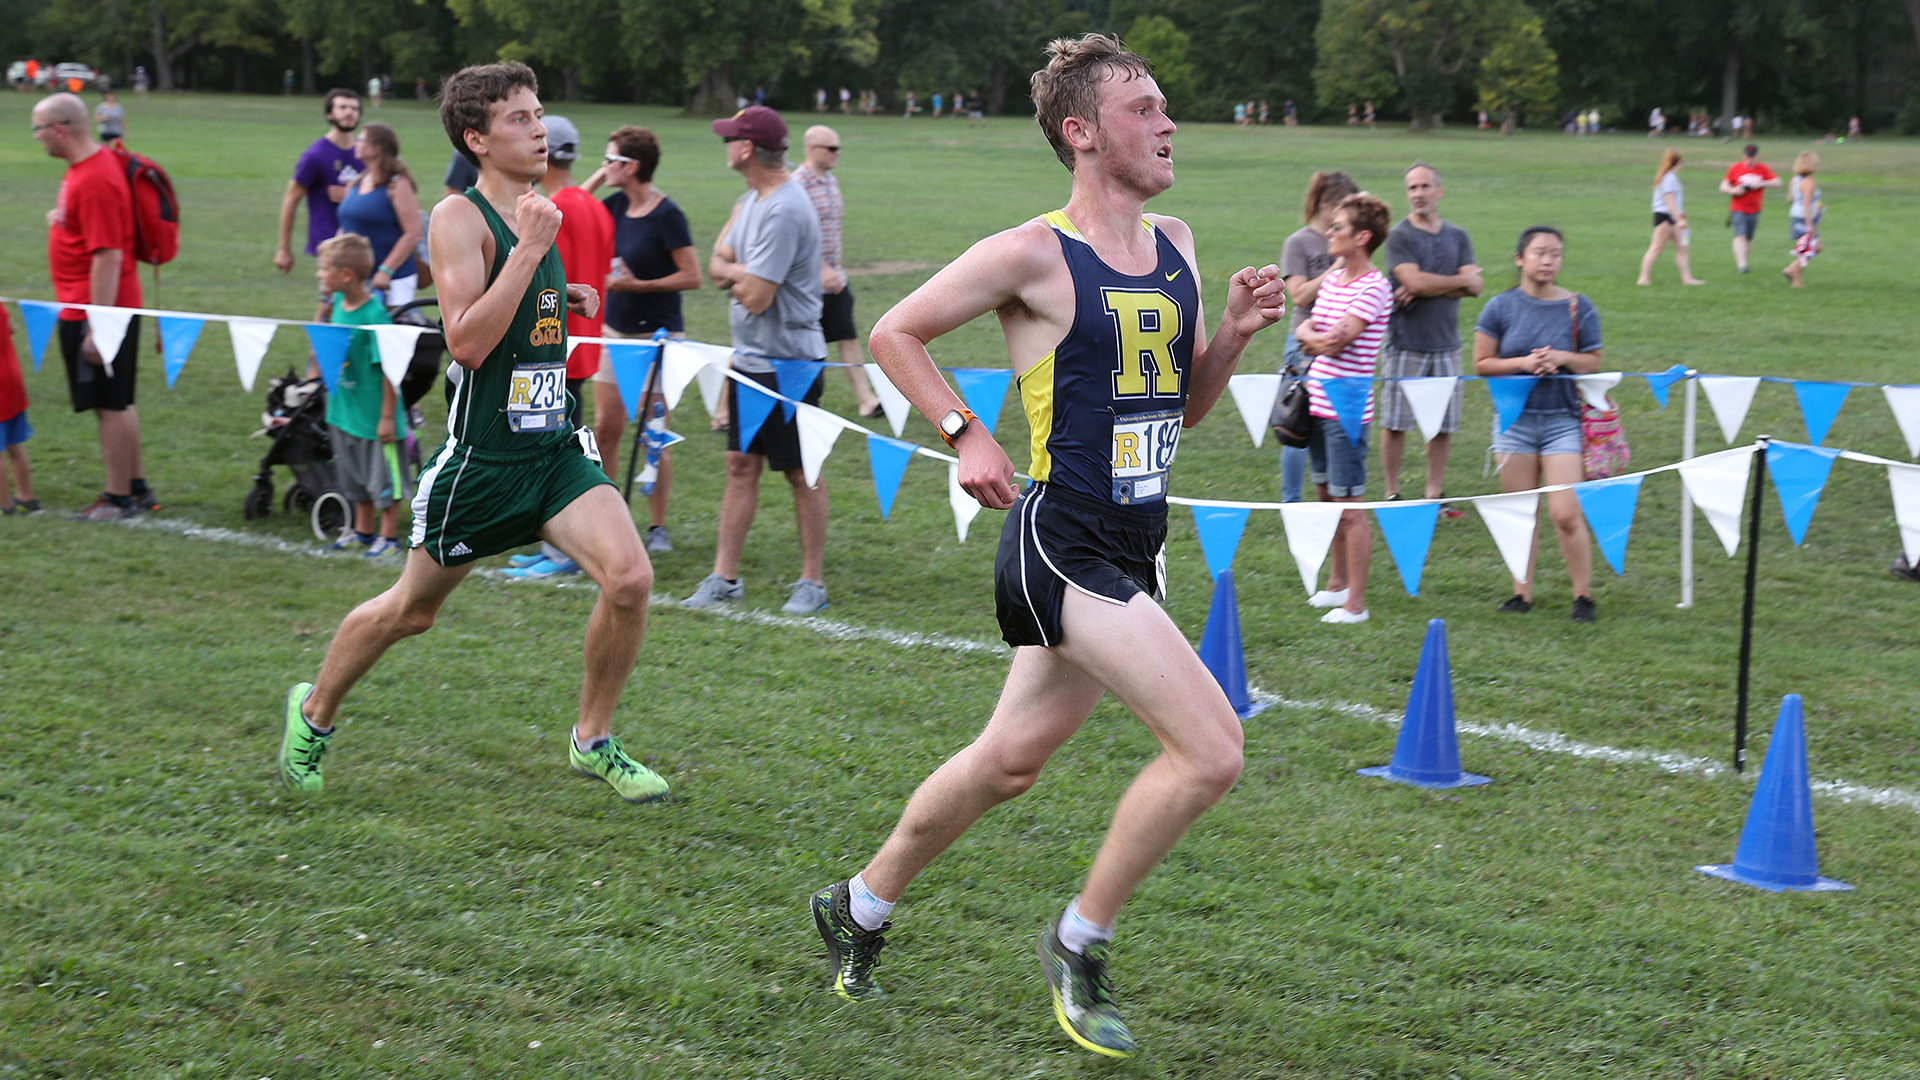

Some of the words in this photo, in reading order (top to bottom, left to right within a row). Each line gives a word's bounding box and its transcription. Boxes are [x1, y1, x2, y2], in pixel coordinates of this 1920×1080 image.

[1100, 286, 1183, 400] R
[510, 377, 531, 404] R
[530, 371, 564, 409] 234
[1114, 431, 1141, 468] R
[1144, 420, 1181, 472] 189
